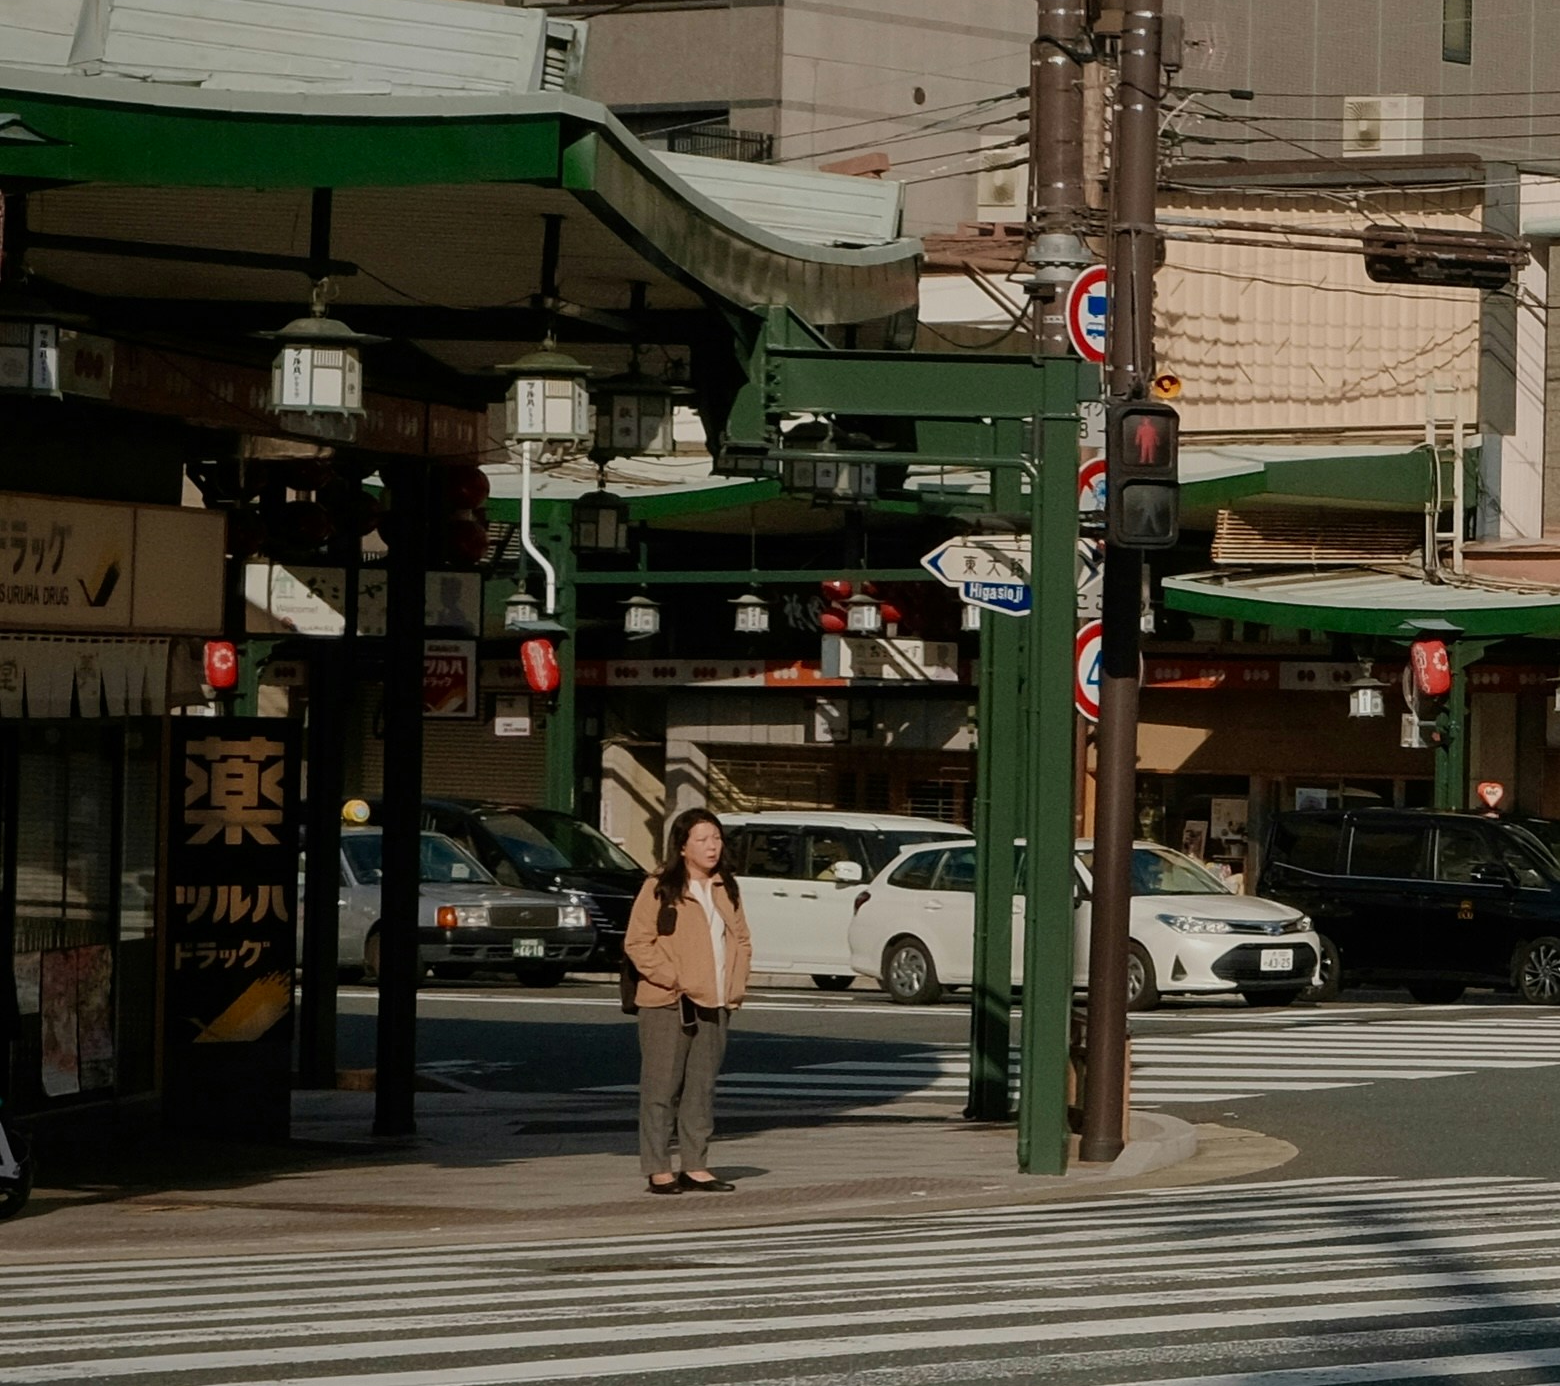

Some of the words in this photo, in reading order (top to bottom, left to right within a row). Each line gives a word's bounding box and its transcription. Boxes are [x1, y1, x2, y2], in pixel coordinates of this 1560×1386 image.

[0, 518, 72, 575] ラッグ
[43, 585, 69, 606] DRUG
[184, 736, 285, 846] 薬
[175, 885, 289, 924] ツルハ
[174, 940, 271, 971] ドラッグ
